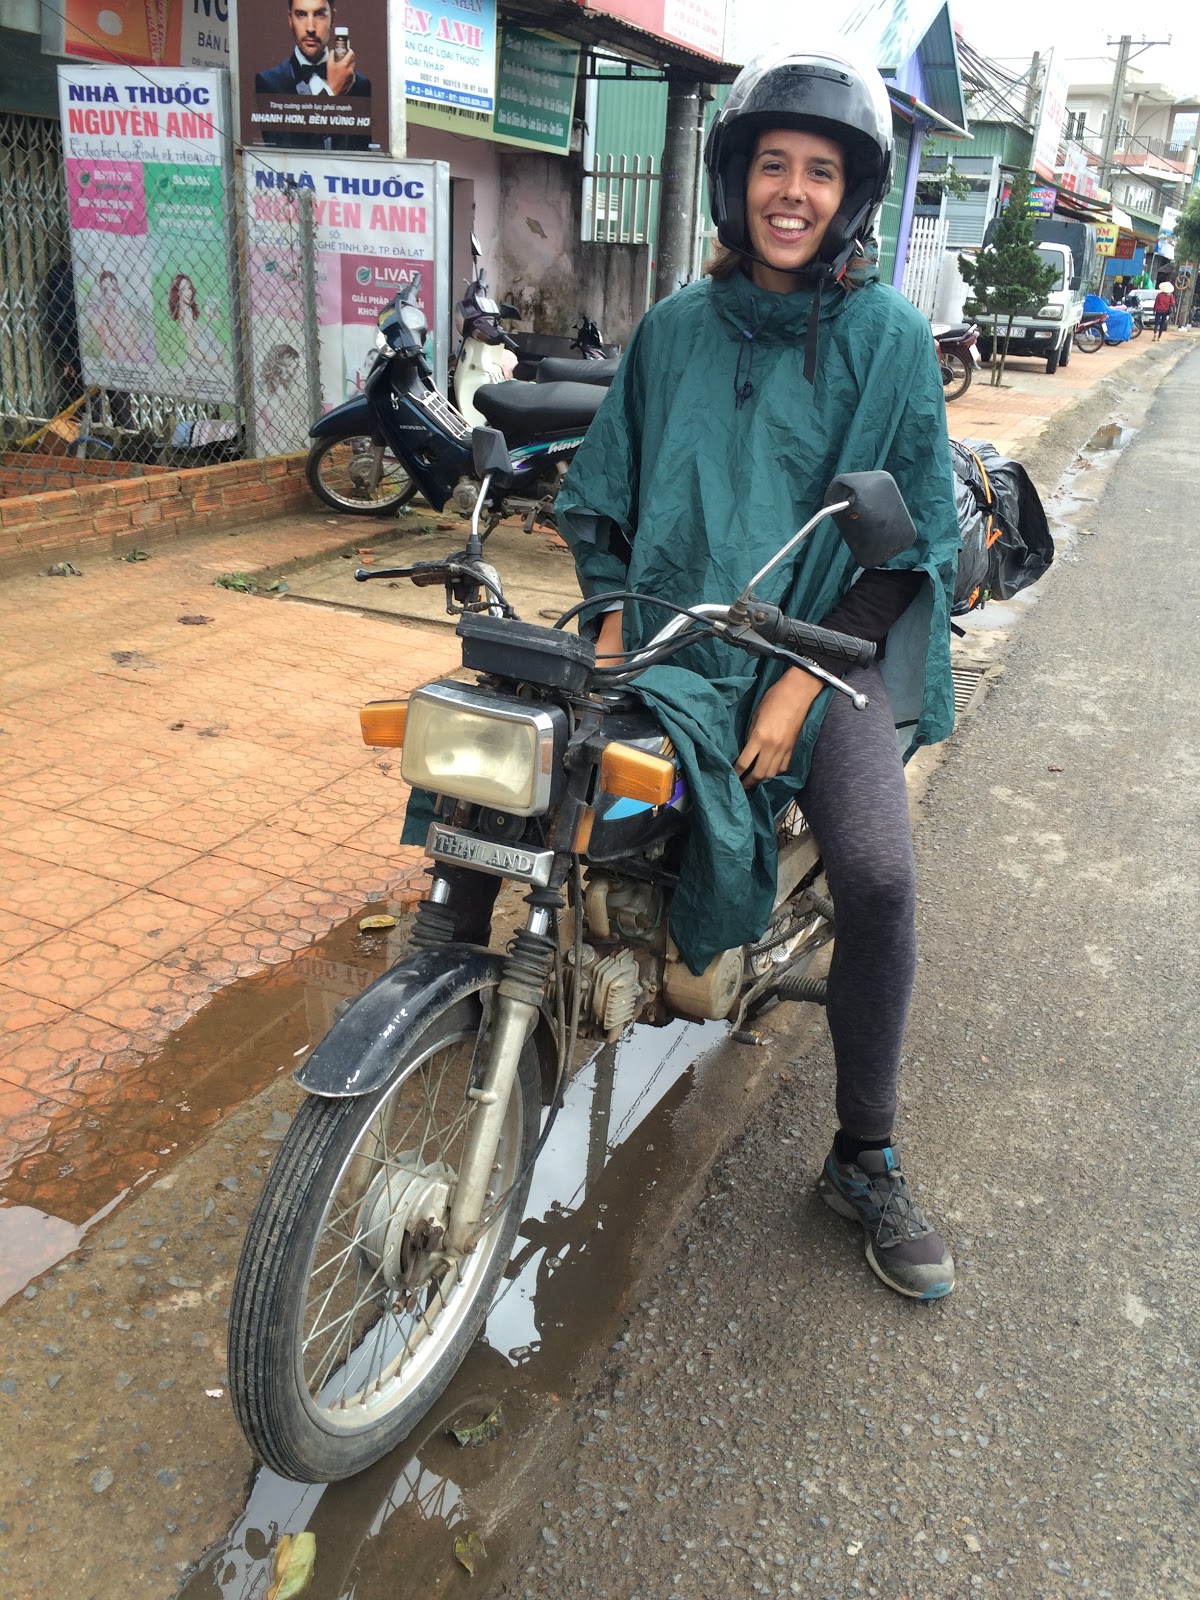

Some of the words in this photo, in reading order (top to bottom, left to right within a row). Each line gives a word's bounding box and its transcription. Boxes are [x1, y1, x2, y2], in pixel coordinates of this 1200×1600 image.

[436, 17, 481, 48] ANH
[68, 82, 119, 103] NHÀ
[125, 81, 209, 105] THUỐC
[166, 112, 214, 139] ANH
[251, 113, 283, 123] NHANH
[255, 170, 316, 191] NHÀ
[324, 174, 424, 199] THUỐC
[253, 194, 361, 229] NGYÊN
[369, 204, 426, 234] ANH
[435, 833, 532, 872] THAILAND
